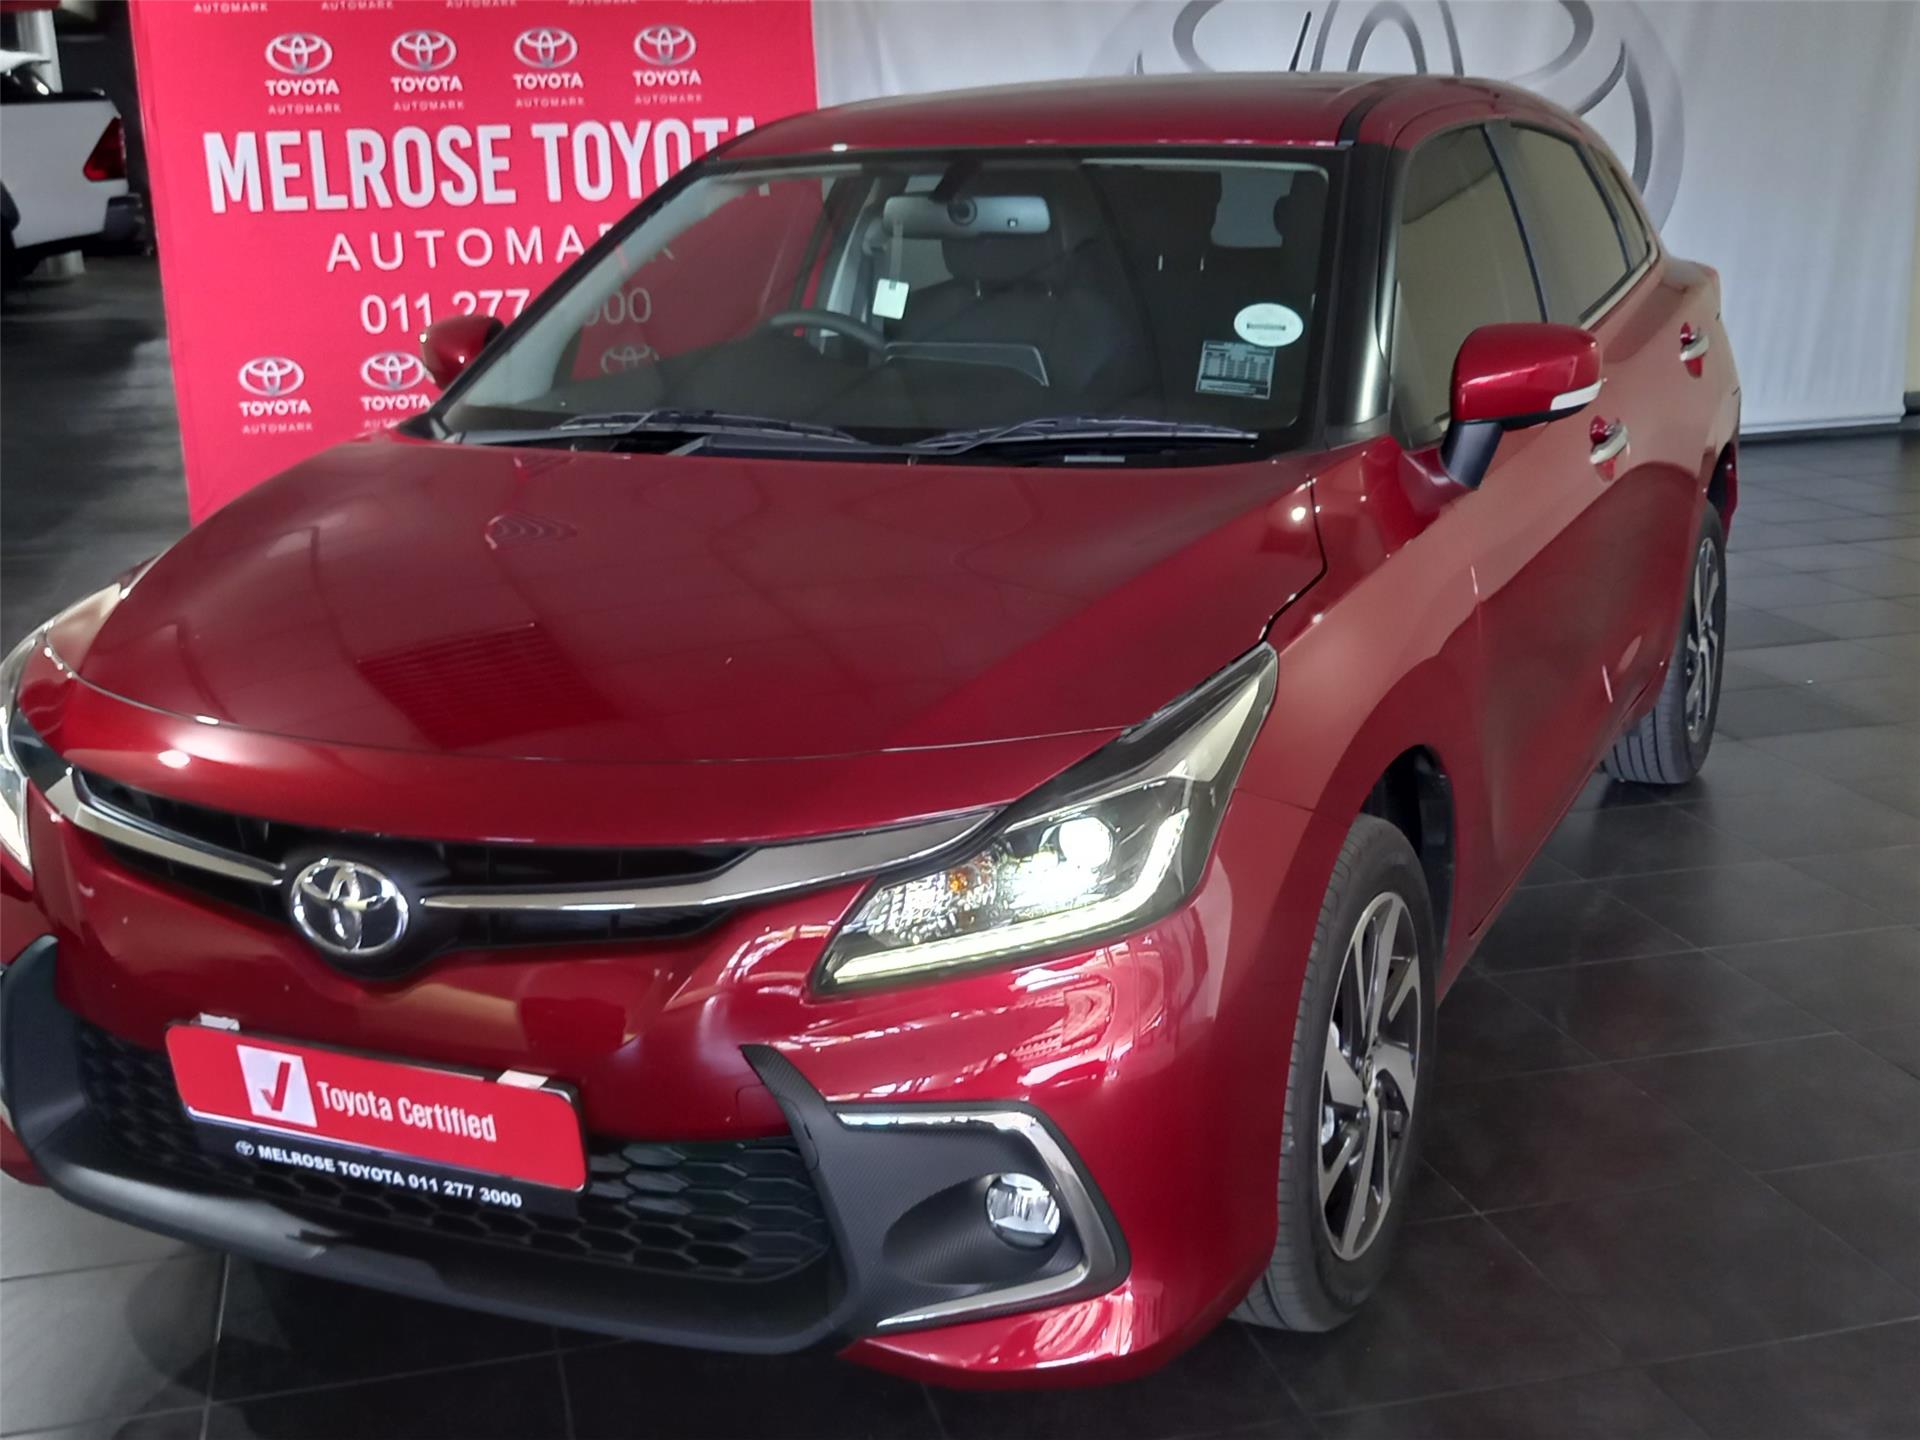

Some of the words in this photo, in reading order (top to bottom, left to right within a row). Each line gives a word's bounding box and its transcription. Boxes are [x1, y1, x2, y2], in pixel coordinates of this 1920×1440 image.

[194, 2, 268, 13] AUTOMARK
[264, 78, 340, 96] TOYOTA
[391, 75, 463, 93] TOYOTA
[512, 72, 584, 90] TOYOTA
[632, 69, 702, 87] TOYOTA
[393, 100, 464, 112] AUTOMARK
[515, 96, 585, 108] AUTOMARK
[634, 93, 703, 105] AUTOMARK
[268, 103, 342, 115] AUTOMARK
[203, 123, 516, 214] MELROSE
[531, 116, 756, 203] TOYOT
[326, 223, 616, 273] AUTOMA
[360, 292, 432, 334] 011
[239, 399, 312, 417] TOYOTA
[360, 394, 432, 411] TOYOTA
[242, 422, 313, 434] AUTOMARK
[316, 1081, 394, 1121] Toyota
[397, 1097, 497, 1142] Certified
[258, 1144, 336, 1173] MELROSE
[337, 1161, 405, 1187] TOYOTA
[408, 1174, 438, 1193] 011
[443, 1180, 474, 1199] 277
[479, 1186, 522, 1208] 3000
